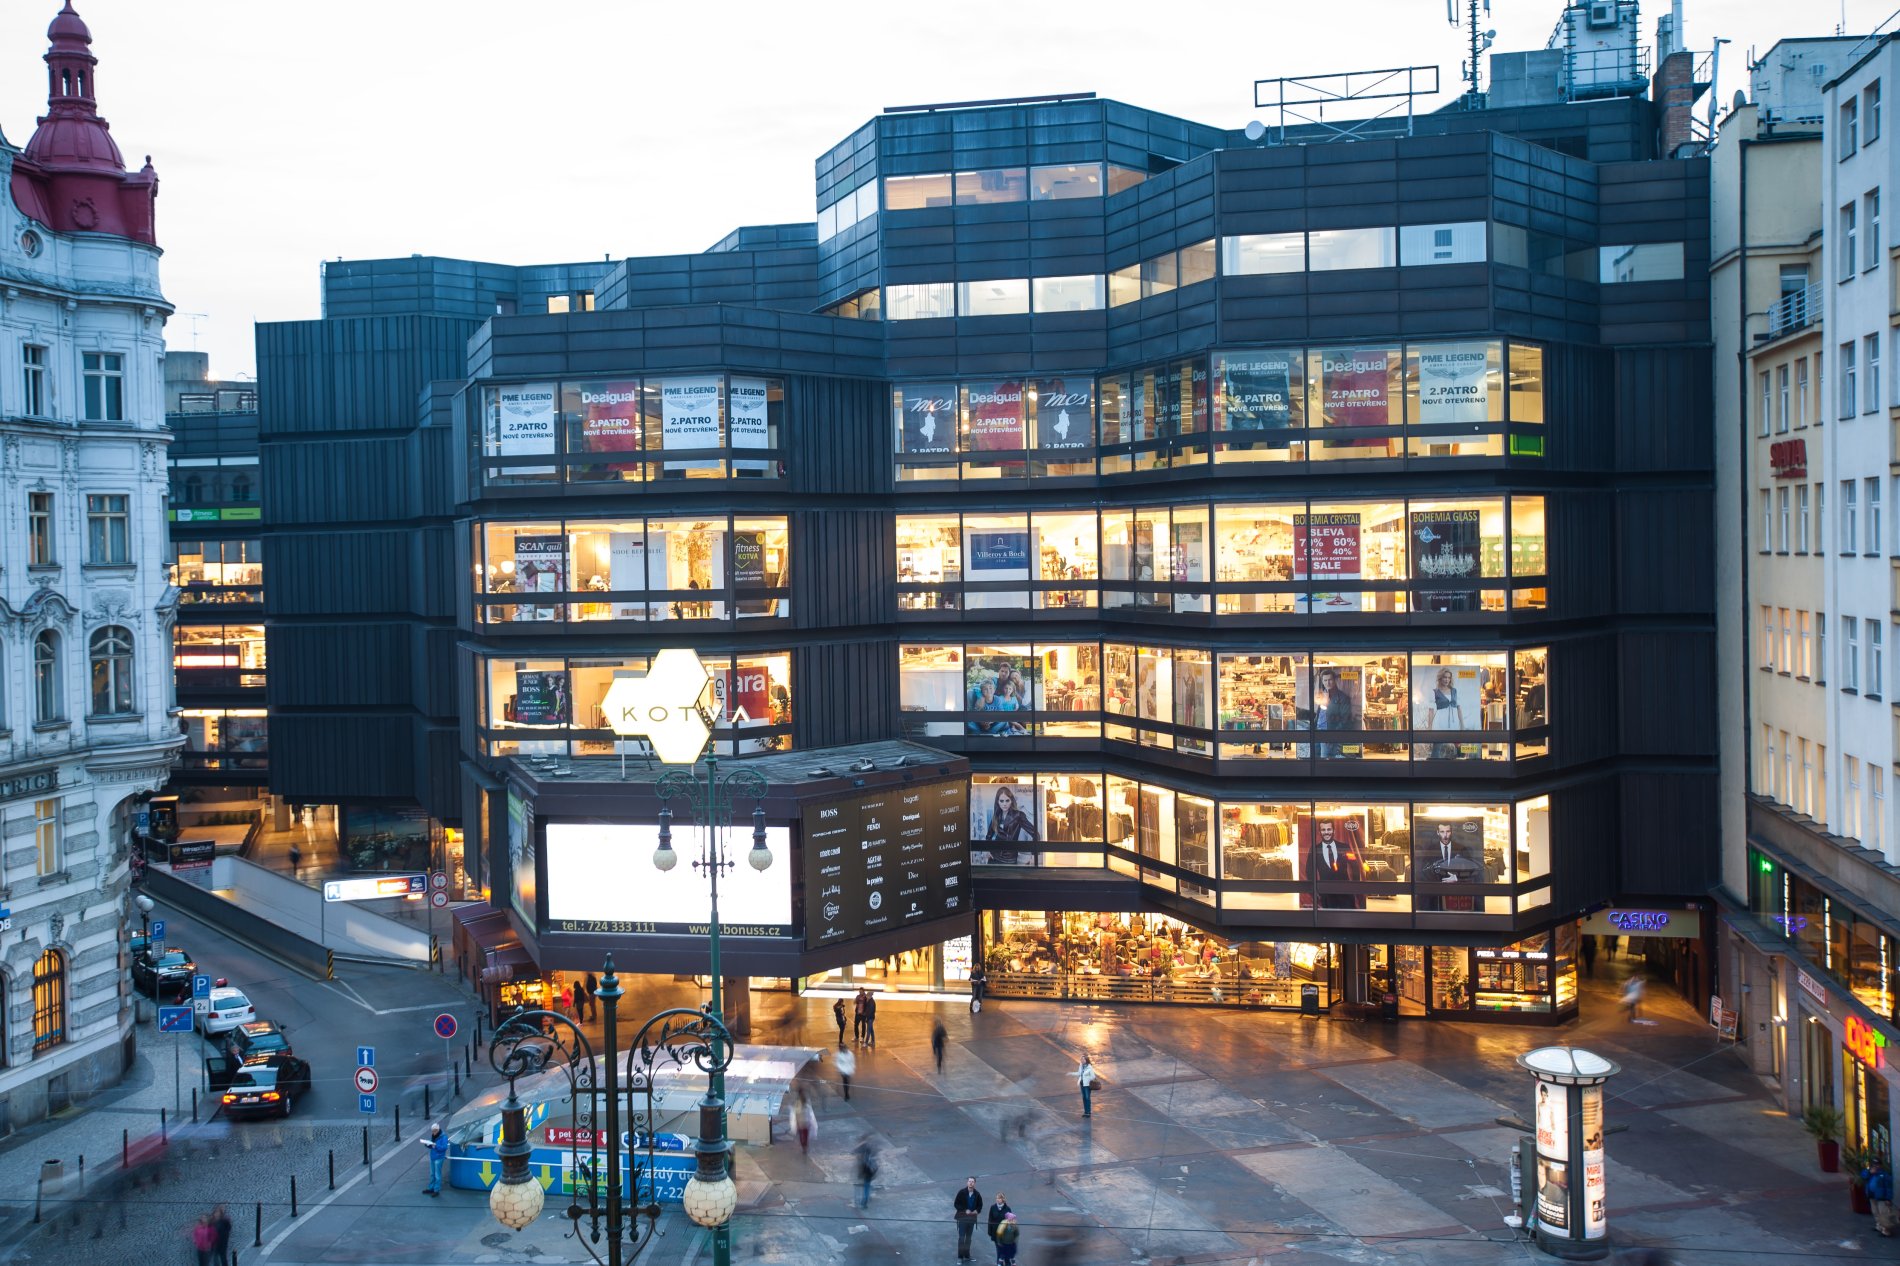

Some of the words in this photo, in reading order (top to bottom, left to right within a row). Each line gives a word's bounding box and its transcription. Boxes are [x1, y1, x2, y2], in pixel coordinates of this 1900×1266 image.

[1421, 354, 1444, 363] PME
[1445, 353, 1485, 362] LEGEND
[1227, 363, 1248, 371] PME
[1250, 361, 1289, 371] LEGEND
[1324, 358, 1387, 374] Desigual
[664, 387, 682, 395] PME
[684, 386, 717, 394] LEGEND
[740, 388, 765, 396] LEGEND
[1331, 389, 1380, 399] 2.PATRO
[1429, 386, 1478, 396] 2.PATRO
[502, 393, 519, 401] PME
[582, 390, 635, 405] Desigual
[970, 391, 1022, 405] Desigual
[1235, 393, 1282, 403] 2.PATRO
[589, 418, 630, 428] 2.PATRO
[671, 416, 711, 425] 2.PATRO
[731, 417, 762, 426] 2.PATRO
[976, 417, 1016, 426] 2.PATRO
[509, 422, 548, 431] 2.PATRO
[1295, 515, 1329, 525] BOEMIA
[1330, 514, 1360, 525] CRYSTAL
[1413, 512, 1451, 523] BOHEMIA
[1453, 511, 1478, 521] GLASS
[1311, 528, 1344, 537] SLEVA
[1333, 537, 1357, 546] 60%
[518, 542, 545, 551] SCAN
[546, 543, 562, 552] quil
[735, 543, 760, 555] fitness
[1332, 547, 1352, 555] 40%
[729, 673, 766, 693] ara
[622, 705, 751, 723] KOTVA
[820, 808, 838, 819] BOSS
[867, 823, 881, 831] FENDI
[1608, 912, 1668, 924] CASINO
[154, 923, 163, 935] P
[562, 921, 584, 931] tel.:
[587, 921, 608, 932] 724
[611, 922, 632, 932] 333
[635, 922, 657, 933] 111
[689, 924, 781, 936] ww.bonuss.cz
[197, 978, 206, 991] P
[363, 1099, 372, 1108] 10
[655, 1186, 684, 1198] 7-22
